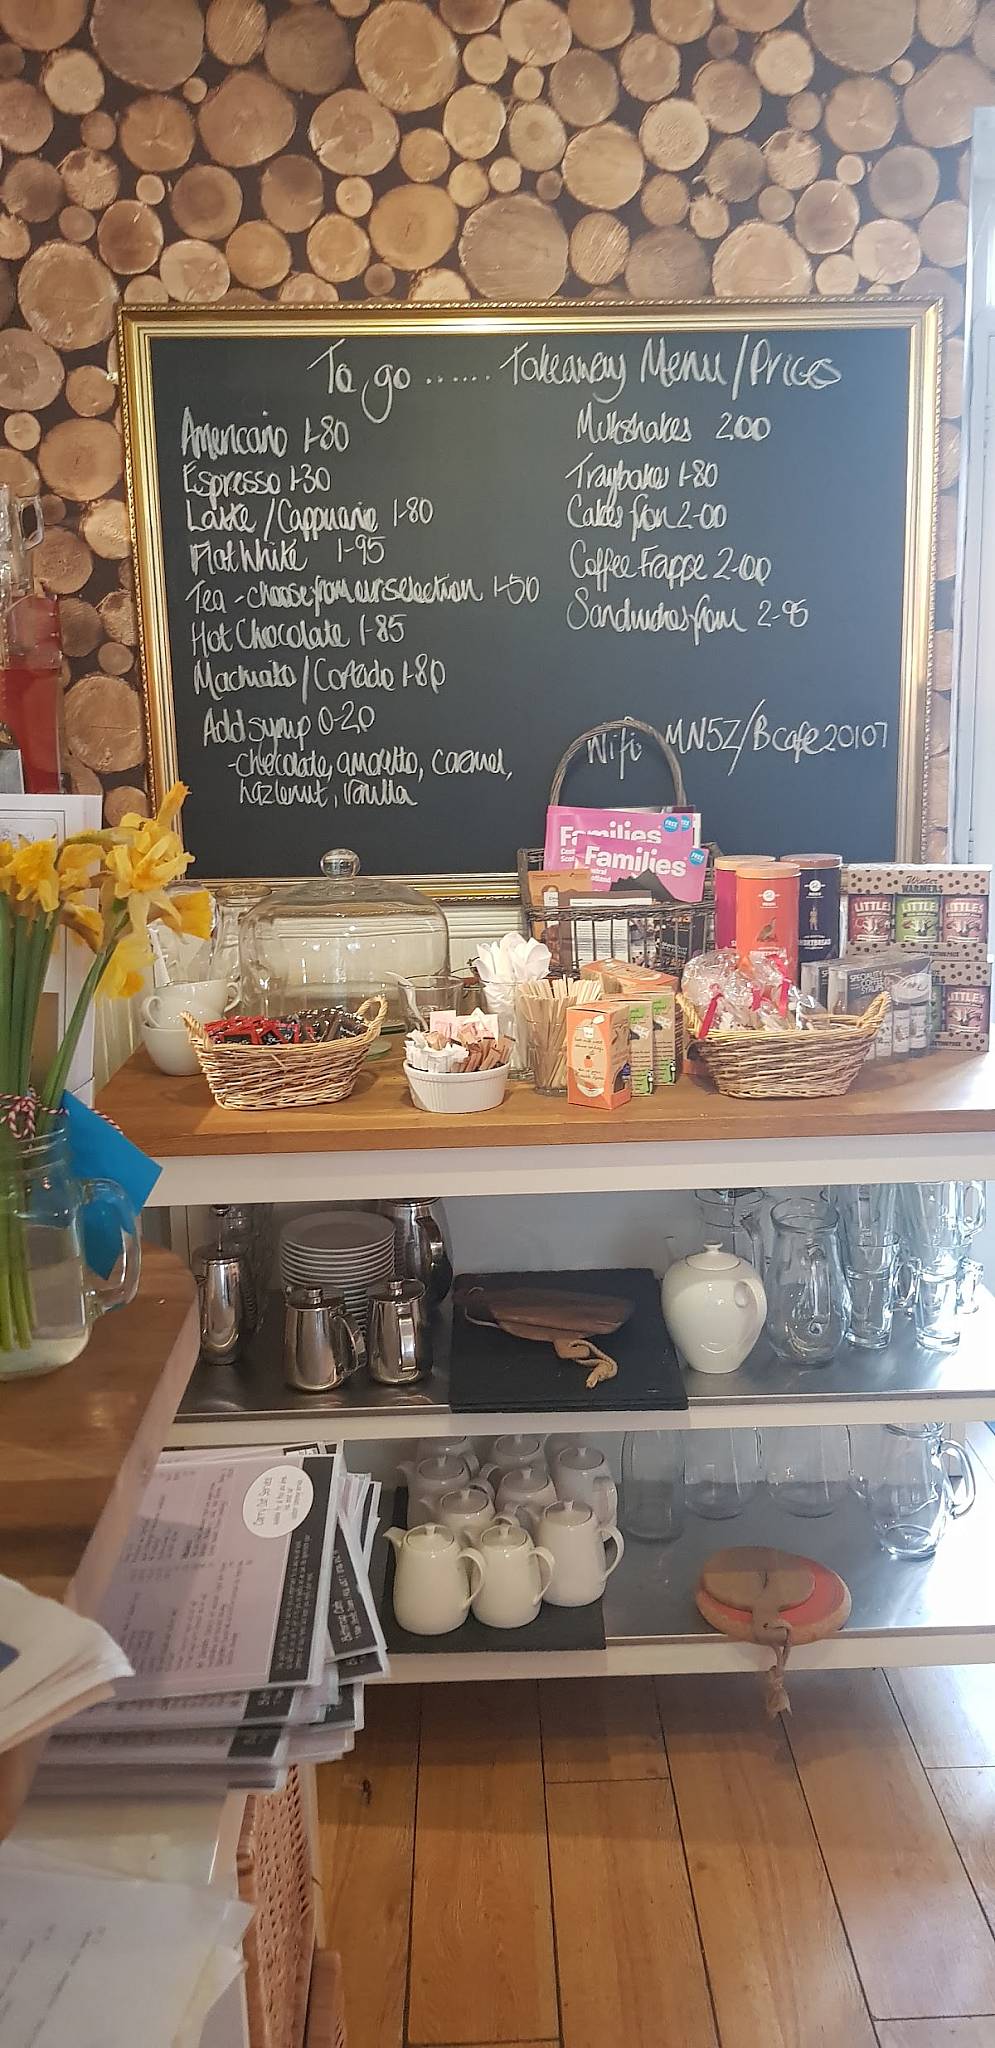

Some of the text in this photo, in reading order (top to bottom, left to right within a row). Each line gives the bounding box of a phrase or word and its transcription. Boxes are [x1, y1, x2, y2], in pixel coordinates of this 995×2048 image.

[307, 338, 357, 394] To
[361, 364, 411, 424] go
[499, 341, 627, 404] Takeaway
[181, 406, 288, 461] Americano
[576, 402, 692, 444] Milkshakes
[183, 460, 281, 511] Espresso
[186, 499, 257, 533] Latte
[567, 494, 623, 529] Cakes
[570, 539, 637, 592] Coffee
[638, 545, 707, 590] Frappe
[185, 579, 227, 614] Tea
[192, 620, 233, 658] Hot
[236, 618, 350, 650] Chocolate
[204, 708, 246, 747] Add
[248, 716, 311, 767] syrup
[585, 845, 687, 877] Families
